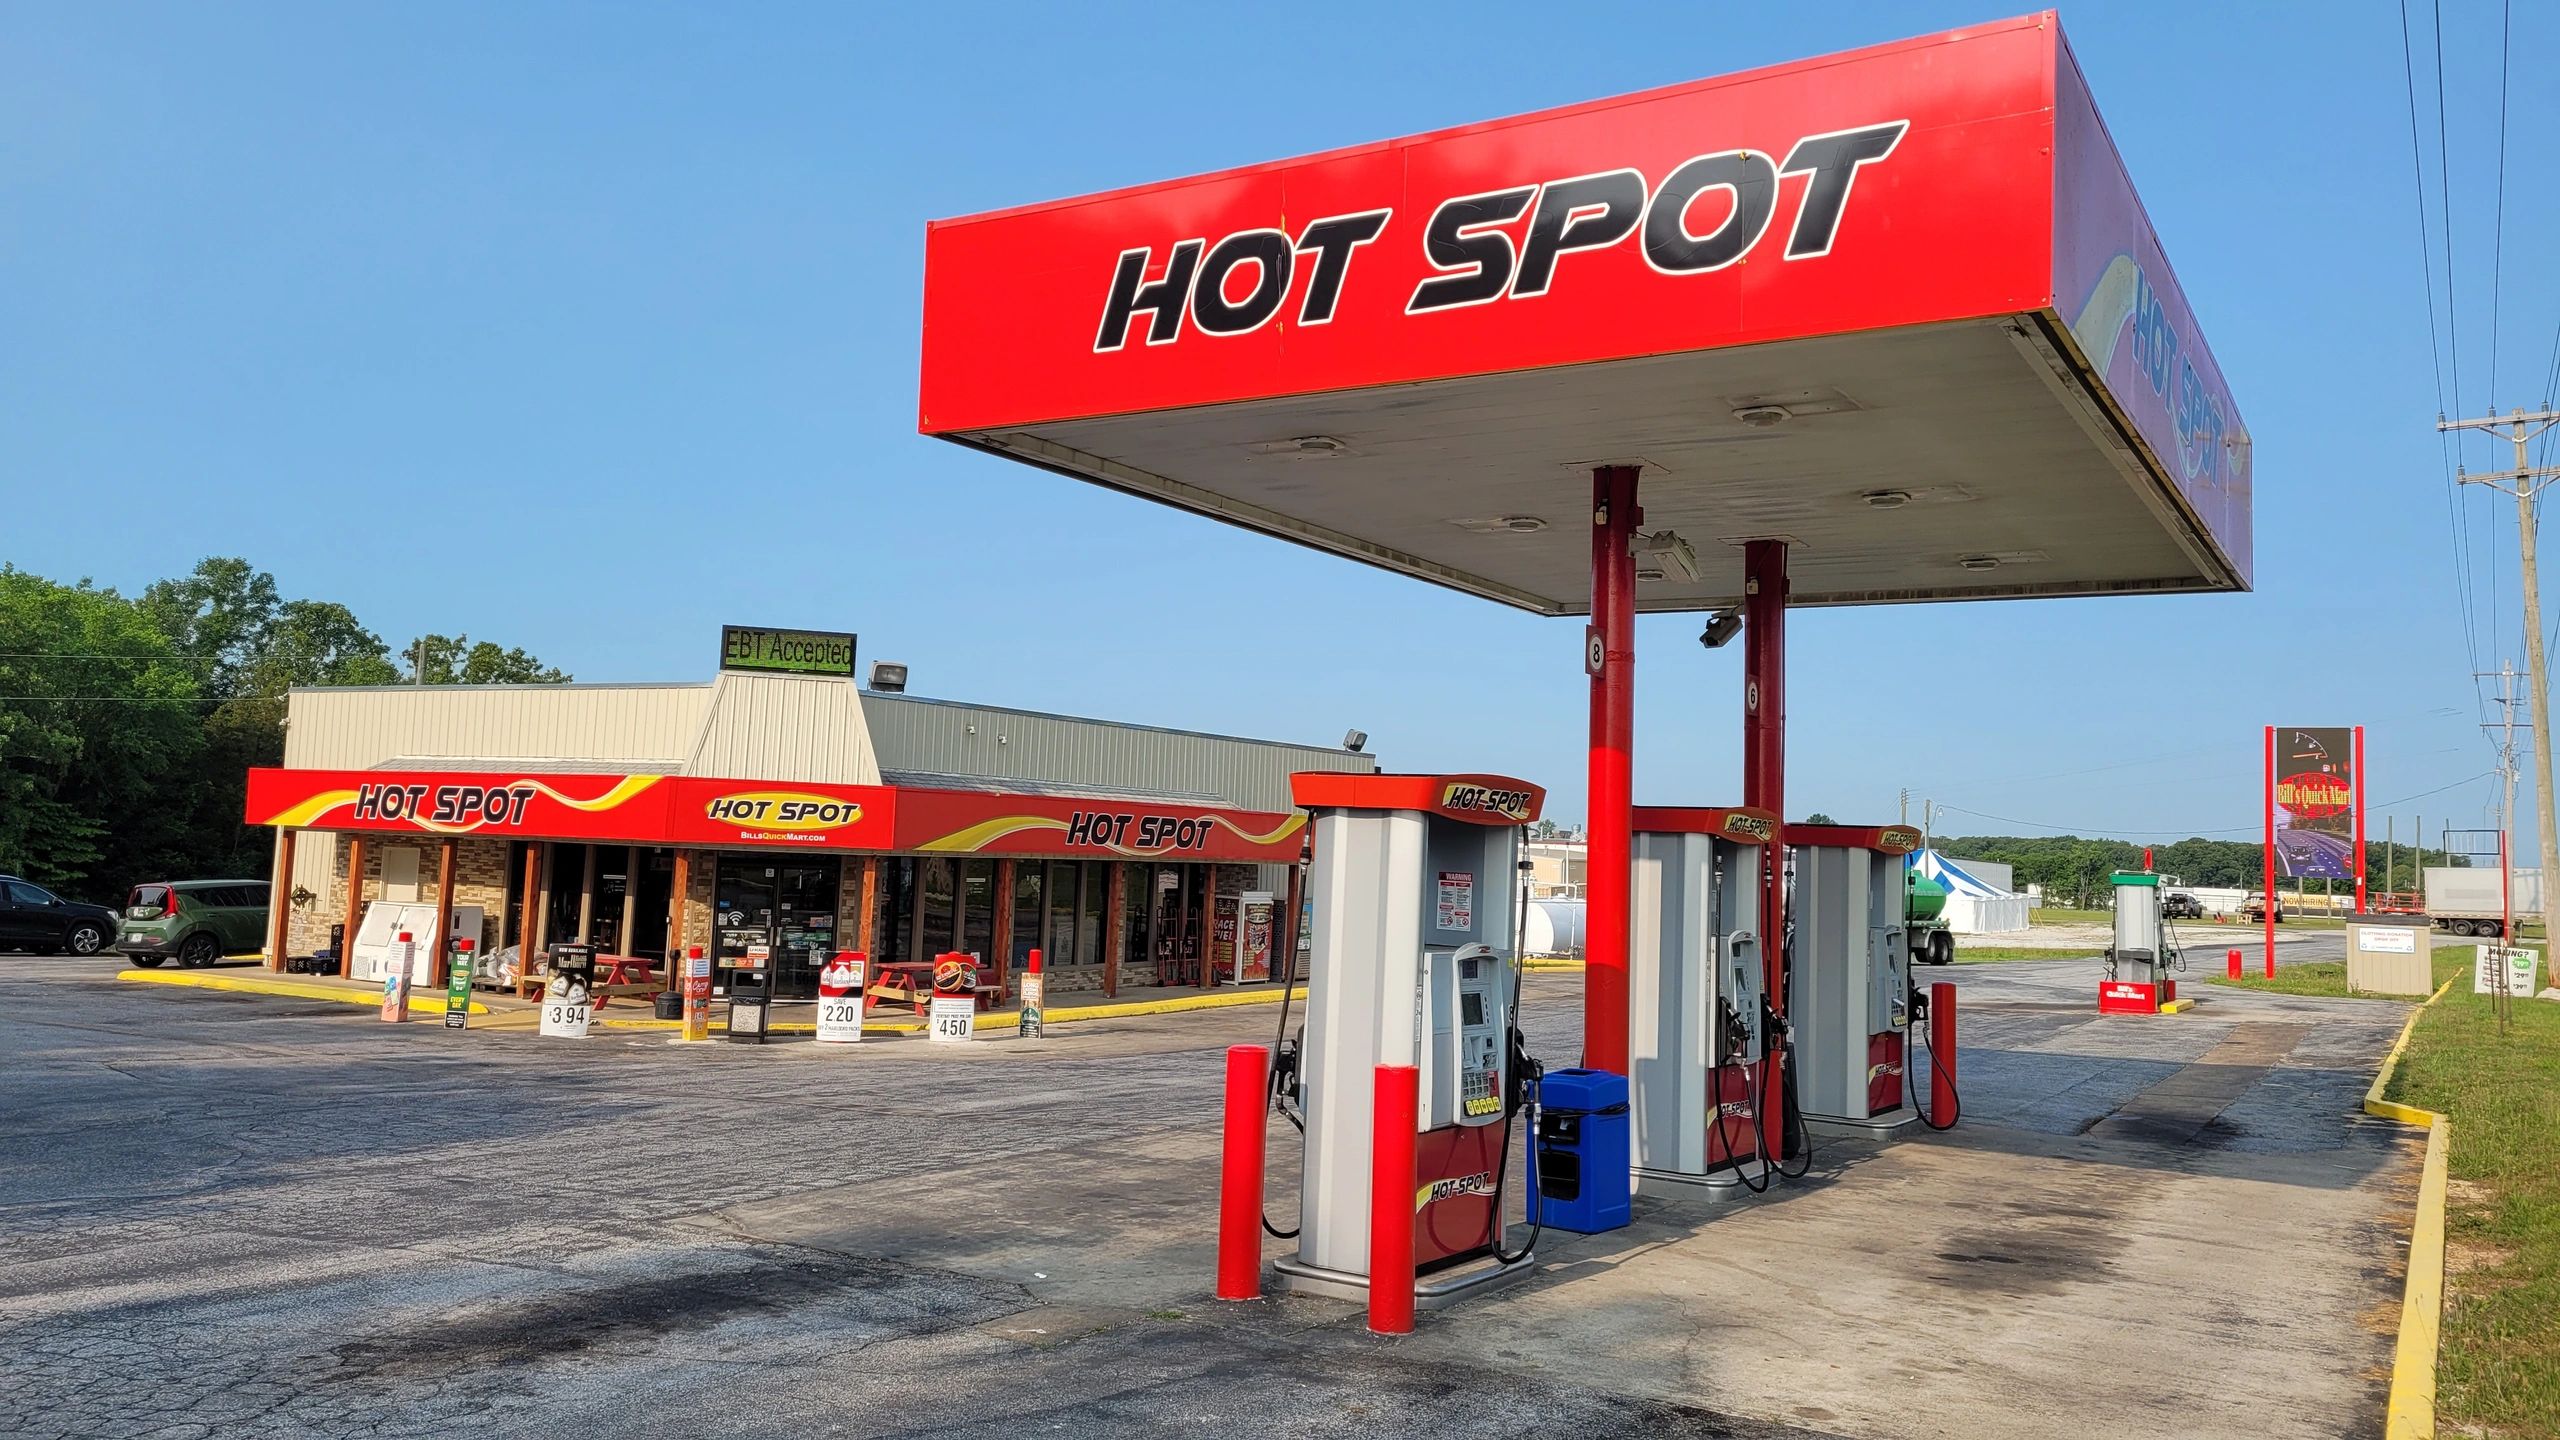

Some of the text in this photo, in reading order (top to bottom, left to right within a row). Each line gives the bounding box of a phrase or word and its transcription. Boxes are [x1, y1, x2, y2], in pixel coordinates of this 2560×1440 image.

[1092, 119, 1910, 354] HOT SPOT
[2133, 264, 2224, 488] HOT SPOT
[726, 630, 852, 671] EBT Accepted
[1593, 643, 1600, 663] 8
[1750, 688, 1756, 704] 6
[354, 784, 536, 825] HOT SPOT
[1447, 786, 1531, 813] HOT SPOT
[2277, 783, 2351, 809] Bill's Quick Mart
[708, 798, 860, 824] HOT SPOT
[1065, 811, 1214, 850] HOT SPOT
[1726, 815, 1774, 835] HOT SPOT
[1446, 873, 1472, 881] WARNING
[2302, 898, 2329, 906] HIRING
[1731, 1100, 1750, 1115] SPOT
[1430, 1171, 1490, 1202] HOT SPOT
